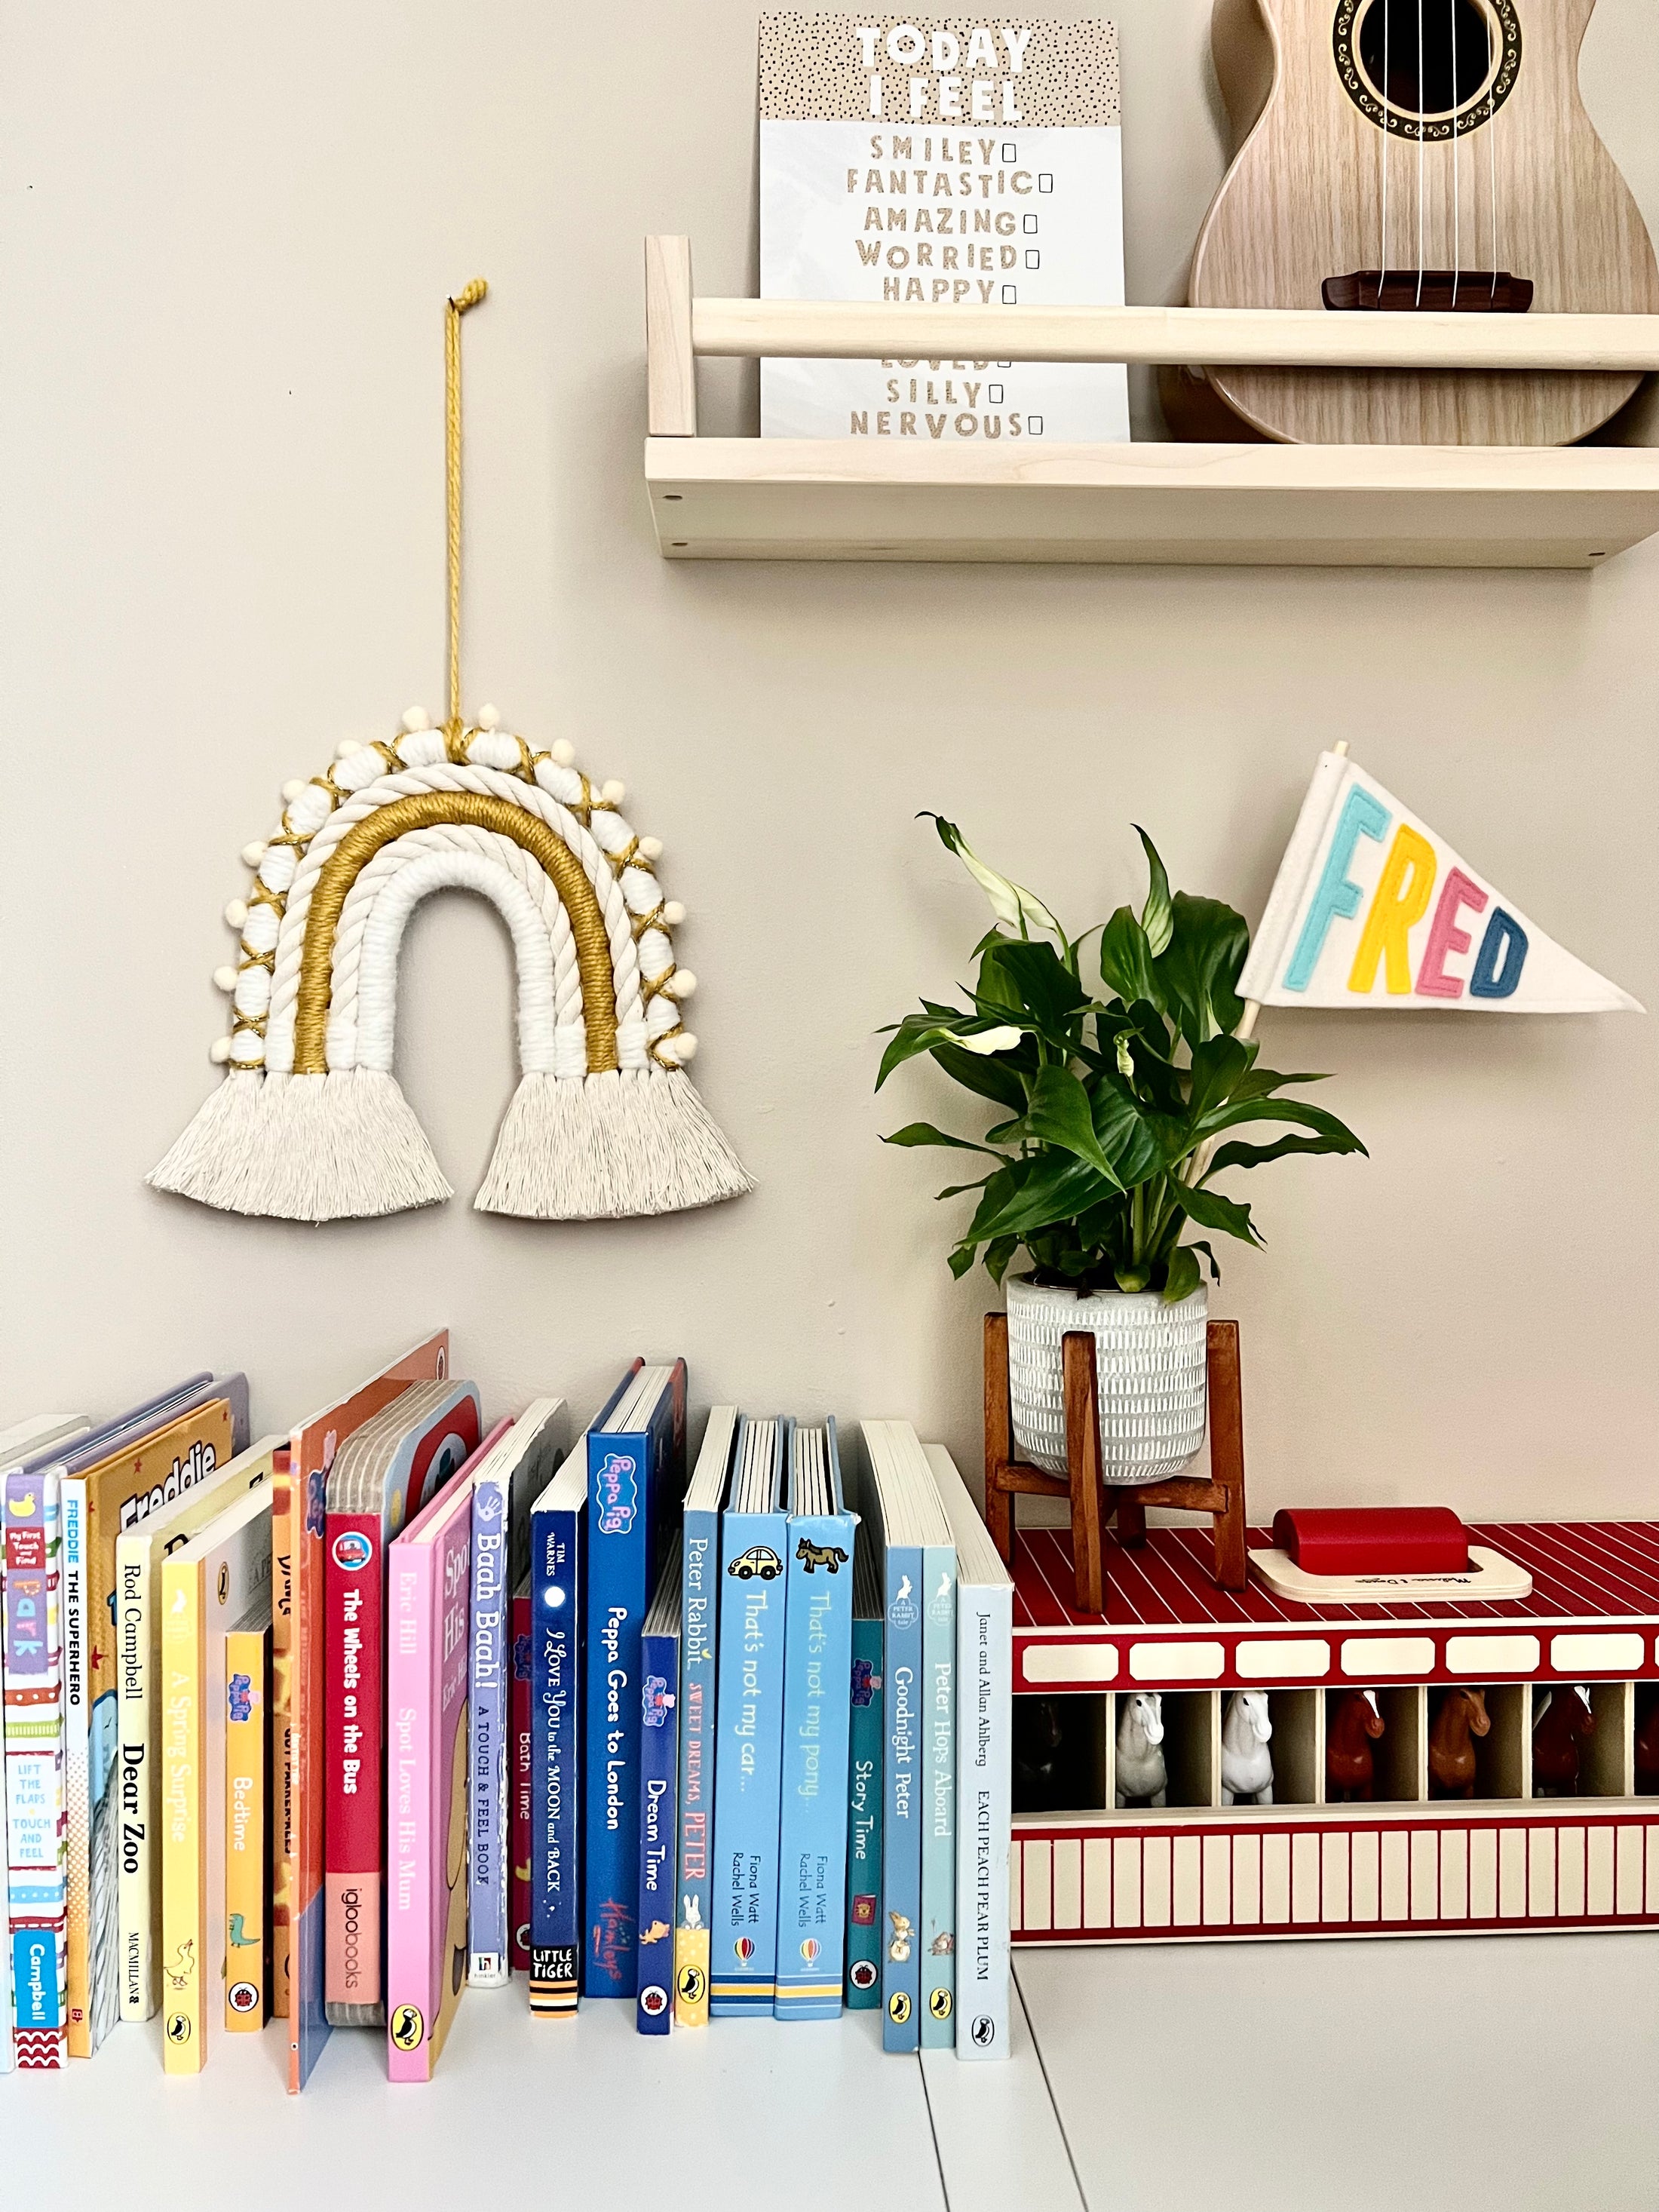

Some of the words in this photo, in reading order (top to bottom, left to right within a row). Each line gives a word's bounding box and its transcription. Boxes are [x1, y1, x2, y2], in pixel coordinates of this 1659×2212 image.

[856, 24, 1032, 72] TODAY
[869, 75, 882, 115] I
[909, 76, 1023, 121] FEEL
[870, 135, 995, 165] SMILEY
[847, 168, 1033, 198] FANTASTIC
[863, 207, 1017, 235] AMAZING
[855, 239, 1017, 272] WORRIED
[883, 277, 995, 303] HAPPY
[886, 379, 981, 408] SILLY
[850, 411, 1022, 439] NERVOUS
[1282, 781, 1529, 999] FRED
[602, 1458, 632, 1503] Peppa
[9, 1532, 22, 1542] My
[23, 1531, 41, 1539] First
[67, 1499, 79, 1563] FREDDIE
[603, 1505, 632, 1531] Pig
[13, 1542, 39, 1550] Touch
[16, 1557, 36, 1565] Find
[545, 1532, 556, 1576] WARNES
[556, 1542, 566, 1563] TIM
[688, 1537, 708, 1591] Peter
[68, 1570, 78, 1603] THE
[124, 1564, 141, 1601] Rod
[476, 1532, 501, 1602] Baah
[343, 1588, 363, 1621] The
[400, 1572, 416, 1613] Eric
[400, 1619, 416, 1655] Hill
[443, 1601, 465, 1663] His
[601, 1607, 627, 1663] Peppa
[687, 1597, 710, 1671] Rabbit
[744, 1589, 768, 1652] That's
[808, 1591, 832, 1655] That's
[977, 1611, 991, 1646] Janet
[68, 1606, 80, 1705] SUPERHERO
[124, 1609, 143, 1700] Campbell
[343, 1628, 363, 1689] Wheels
[475, 1610, 500, 1689] Baah!
[979, 1650, 991, 1674] and
[172, 1671, 189, 1687] A
[606, 1670, 627, 1723] Goes
[742, 1660, 762, 1698] not
[806, 1661, 826, 1698] not
[935, 1661, 952, 1713] Peter
[979, 1678, 991, 1713] Allan
[167, 1695, 192, 1758] Spring
[343, 1695, 357, 1718] on
[478, 1705, 489, 1717] A
[688, 1683, 703, 1735] SWEET
[734, 1703, 757, 1738] my
[799, 1704, 820, 1738] my
[892, 1666, 915, 1763] Goodnight
[343, 1724, 363, 1753] the
[395, 1707, 416, 1752] Spot
[478, 1722, 489, 1777] TOUCH
[547, 1731, 561, 1742] to
[606, 1732, 625, 1754] to
[932, 1720, 952, 1763] Hops
[975, 1717, 990, 1767] Ahlberg
[18, 1764, 41, 1775] LIFT
[520, 1732, 531, 1772] Bath
[547, 1744, 562, 1761] the
[740, 1744, 755, 1793] car...
[20, 1779, 41, 1790] THE
[123, 1743, 146, 1815] Dear
[343, 1759, 360, 1795] Bus
[398, 1756, 416, 1815] Loves
[478, 1782, 489, 1792] &
[547, 1766, 562, 1819] MOON
[606, 1759, 627, 1830] London
[851, 1760, 873, 1812] Story
[895, 1773, 912, 1818] Peter
[15, 1793, 45, 1805] FLAPS
[167, 1763, 192, 1842] Surprise
[233, 1777, 253, 1852] Bedtime
[477, 1799, 489, 1838] FEEL
[646, 1779, 667, 1842] Dream
[934, 1769, 952, 1837] Aboard
[978, 1790, 990, 1832] EACH
[13, 1818, 51, 1830] TOUCH
[20, 1833, 41, 1844] AND
[398, 1821, 416, 1855] His
[547, 1822, 560, 1844] and
[854, 1815, 874, 1860] Time
[20, 1847, 44, 1858] FEEL
[123, 1823, 146, 1873] Zoo
[477, 1843, 489, 1885] BOOK
[685, 1812, 707, 1881] PETER
[977, 1836, 989, 1888] PEACH
[398, 1858, 416, 1910] Mum
[547, 1846, 561, 1892] BACK
[646, 1845, 666, 1891] Time
[731, 1852, 744, 1890] Rachel
[750, 1855, 761, 1888] Fiona
[799, 1853, 811, 1891] Rachel
[816, 1855, 828, 1889] Fiona
[731, 1893, 744, 1927] Wells
[747, 1891, 760, 1924] Watt
[798, 1894, 811, 1928] Wells
[814, 1892, 828, 1925] Watt
[977, 1891, 989, 1938] PEAR
[341, 1888, 362, 1989] igloobooks
[593, 1897, 635, 1981] Hamleys
[977, 1940, 989, 1980] PLUM
[28, 1943, 45, 2021] Campbell
